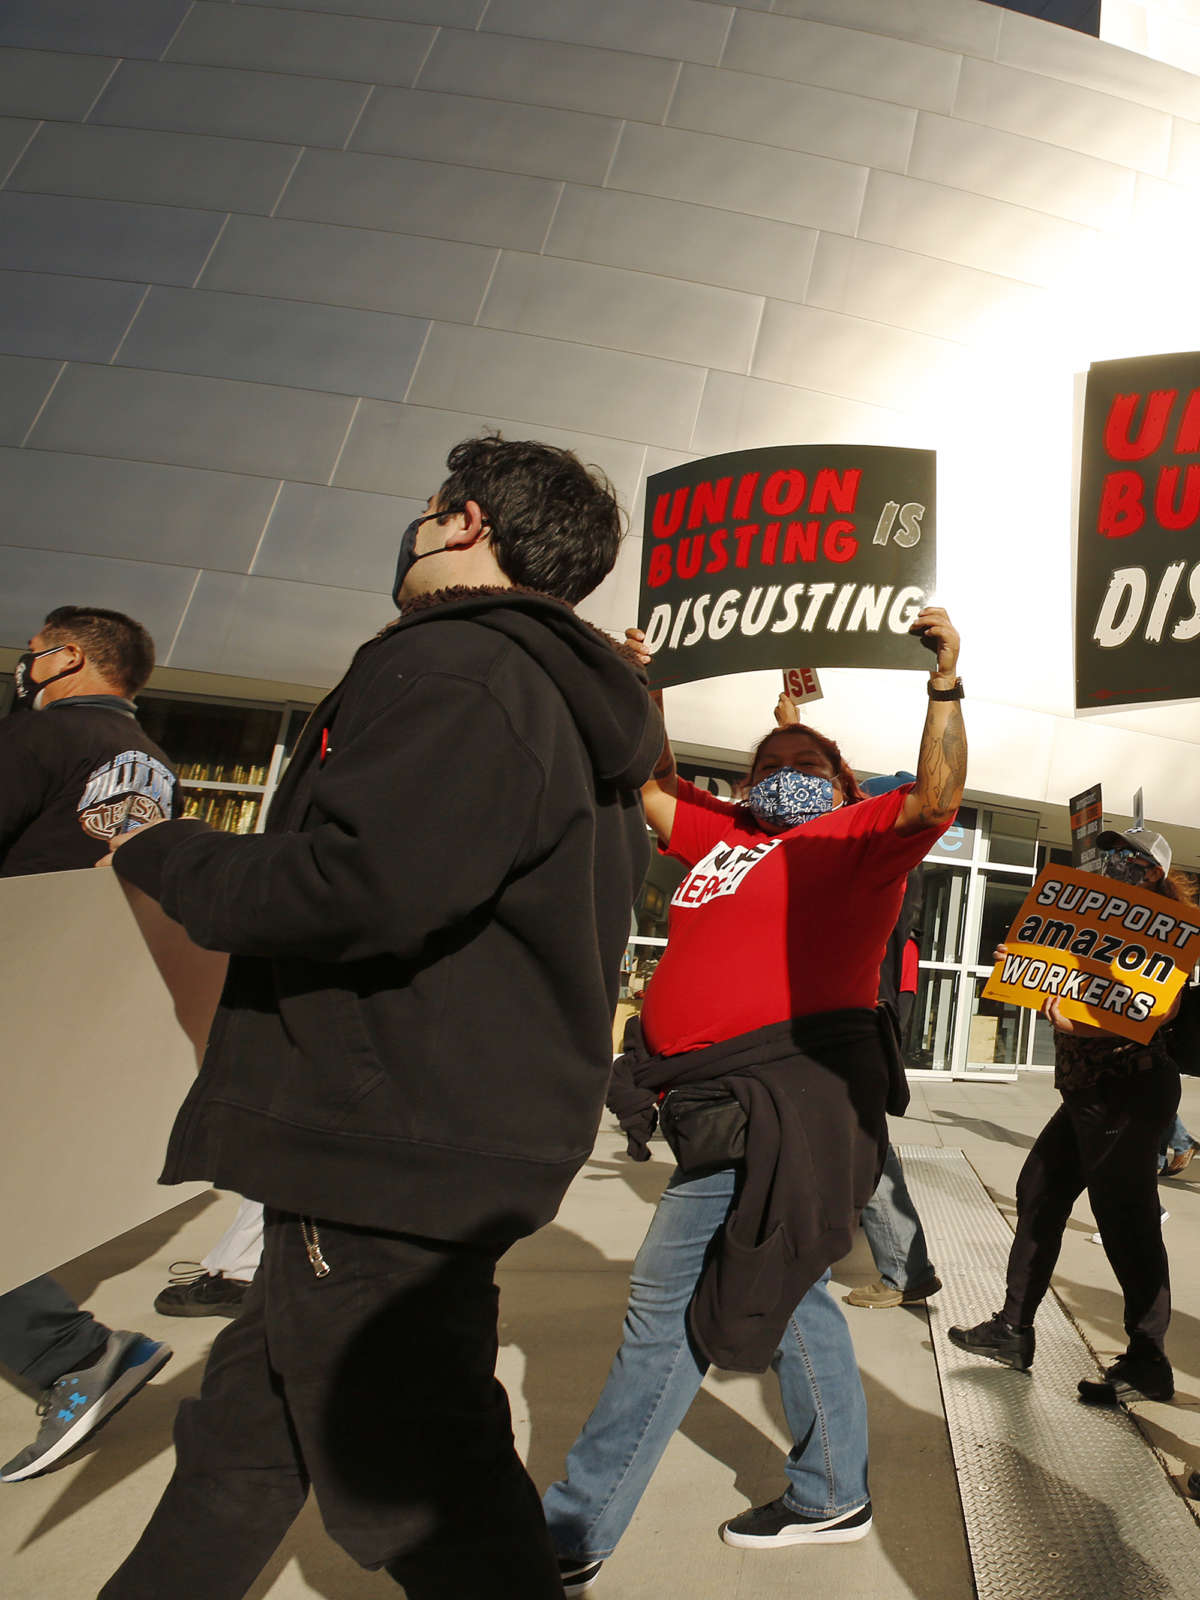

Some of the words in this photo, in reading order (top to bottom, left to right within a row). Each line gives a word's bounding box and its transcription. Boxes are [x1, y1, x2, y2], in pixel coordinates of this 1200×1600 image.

[651, 468, 863, 540] UNION
[647, 519, 859, 589] BUSTING
[873, 500, 926, 548] IS
[646, 582, 928, 654] DISGUSTING
[1017, 914, 1175, 984] amazon
[1036, 880, 1200, 949] SUPPORT
[1000, 954, 1156, 1021] WORKERS
